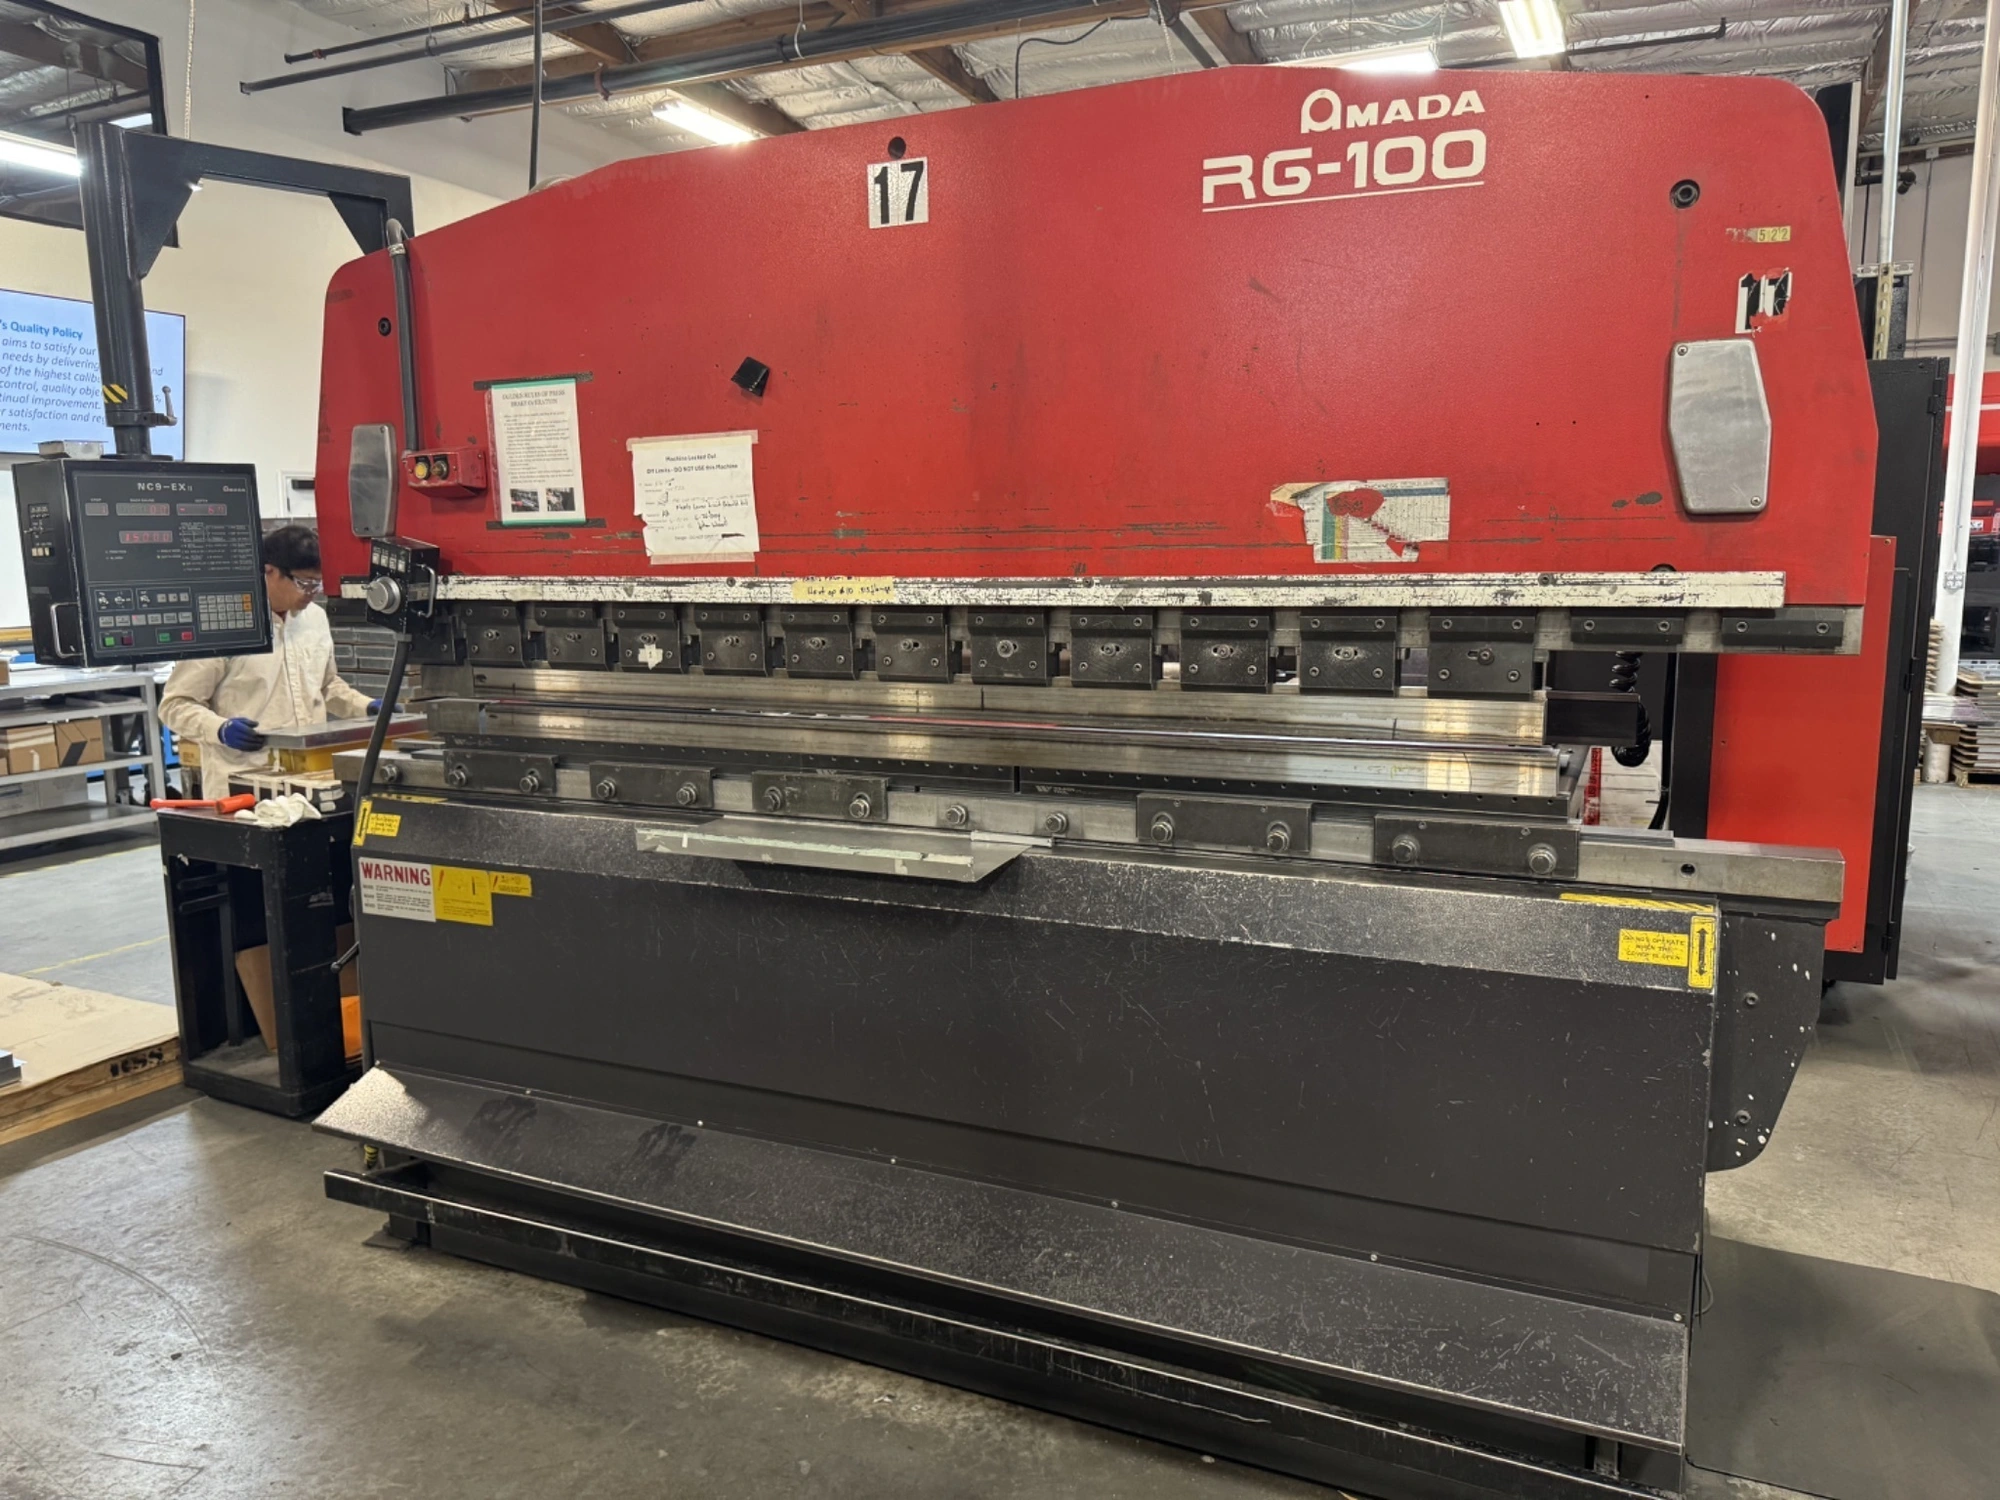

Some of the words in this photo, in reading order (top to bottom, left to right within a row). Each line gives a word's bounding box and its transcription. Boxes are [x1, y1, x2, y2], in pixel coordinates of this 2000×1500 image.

[1301, 88, 1486, 134] AMADA
[1202, 129, 1487, 204] RG-100
[873, 160, 925, 225] 17
[10, 321, 50, 336] Quality
[52, 326, 84, 341] Policy
[2, 337, 28, 348] aims
[30, 340, 41, 350] to
[43, 342, 77, 356] satisfy
[79, 346, 97, 356] our
[2, 352, 34, 363] needs
[36, 353, 49, 366] by
[51, 356, 100, 371] delivering
[0, 363, 12, 377] of
[14, 366, 31, 376] the
[34, 367, 71, 380] highest
[42, 384, 77, 397] quality
[79, 387, 102, 398] obje
[31, 395, 101, 409] improvement.
[8, 408, 68, 421] satisfaction
[71, 413, 91, 422] and
[137, 482, 186, 492] NC9-EX
[361, 862, 432, 886] WARNING
